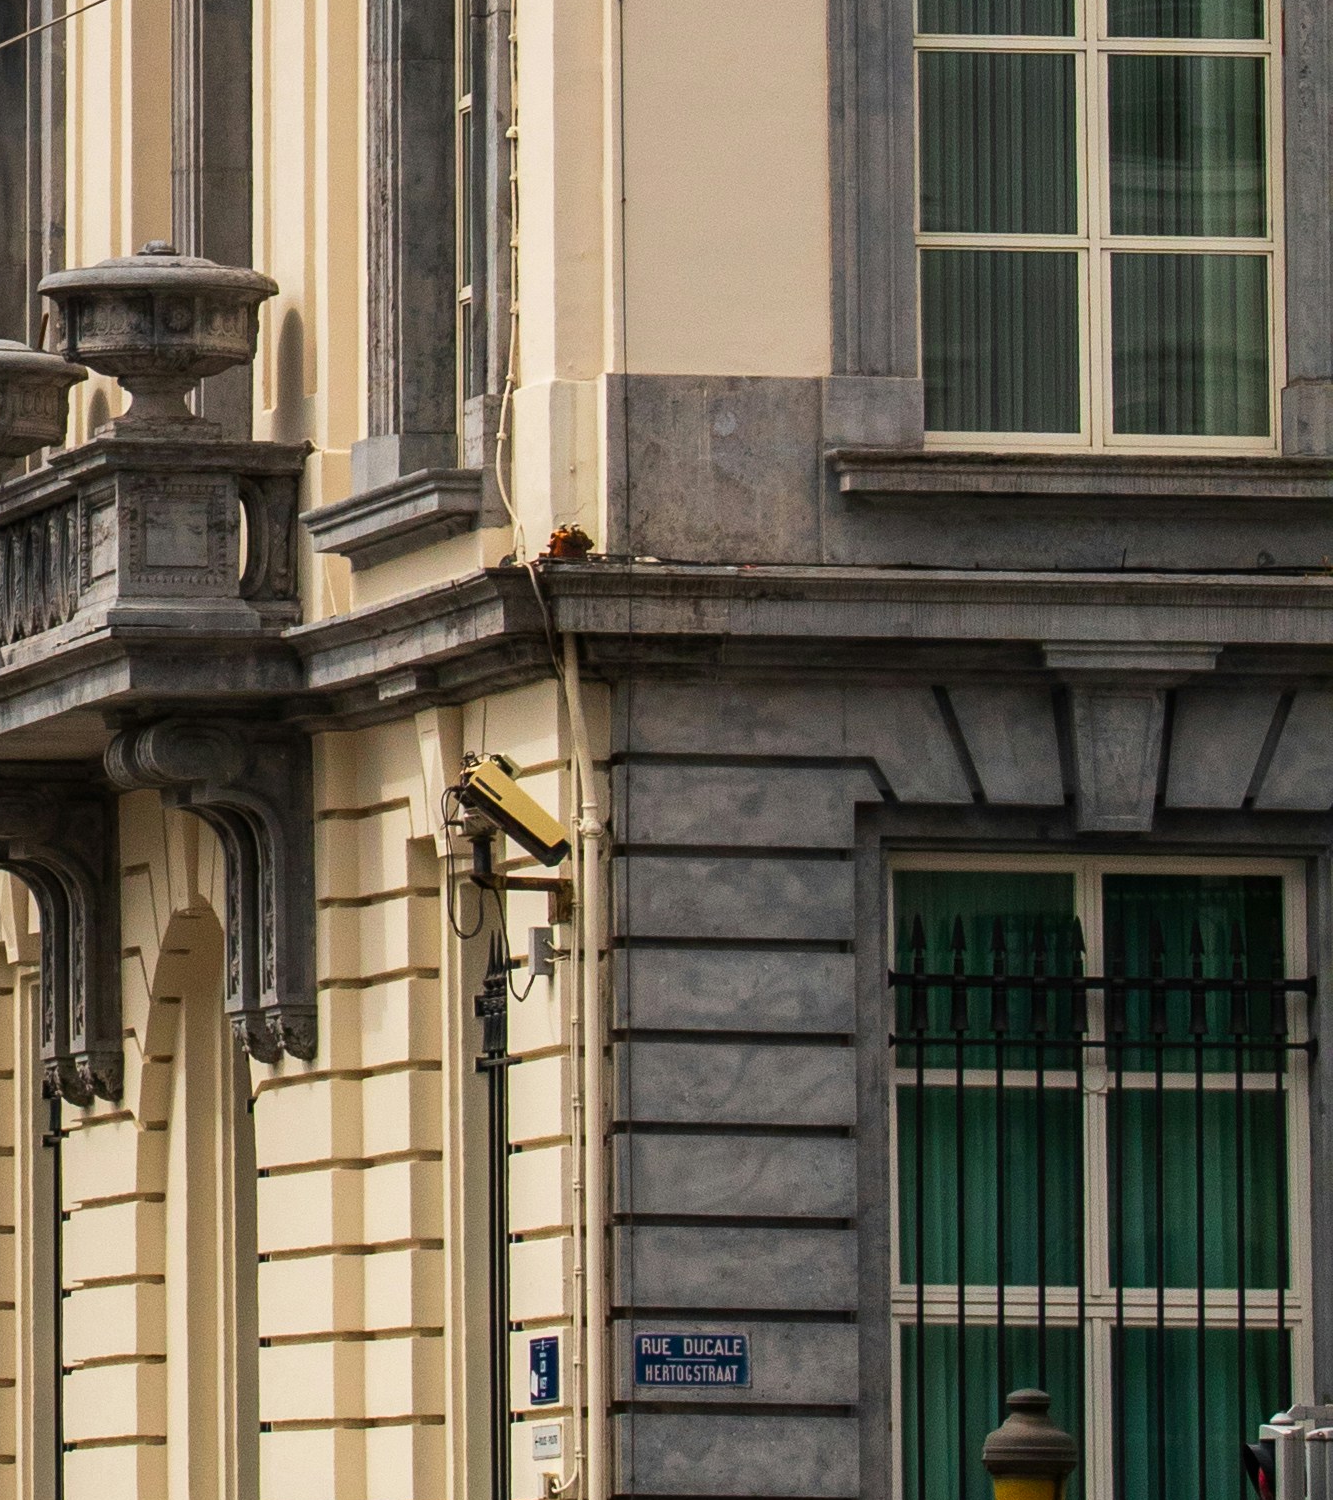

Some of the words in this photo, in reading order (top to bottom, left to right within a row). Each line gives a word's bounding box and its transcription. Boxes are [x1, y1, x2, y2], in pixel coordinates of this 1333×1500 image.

[641, 1338, 672, 1356] RUE
[684, 1338, 743, 1356] DUCALE
[645, 1364, 739, 1382] HERTOGSTRAAT
